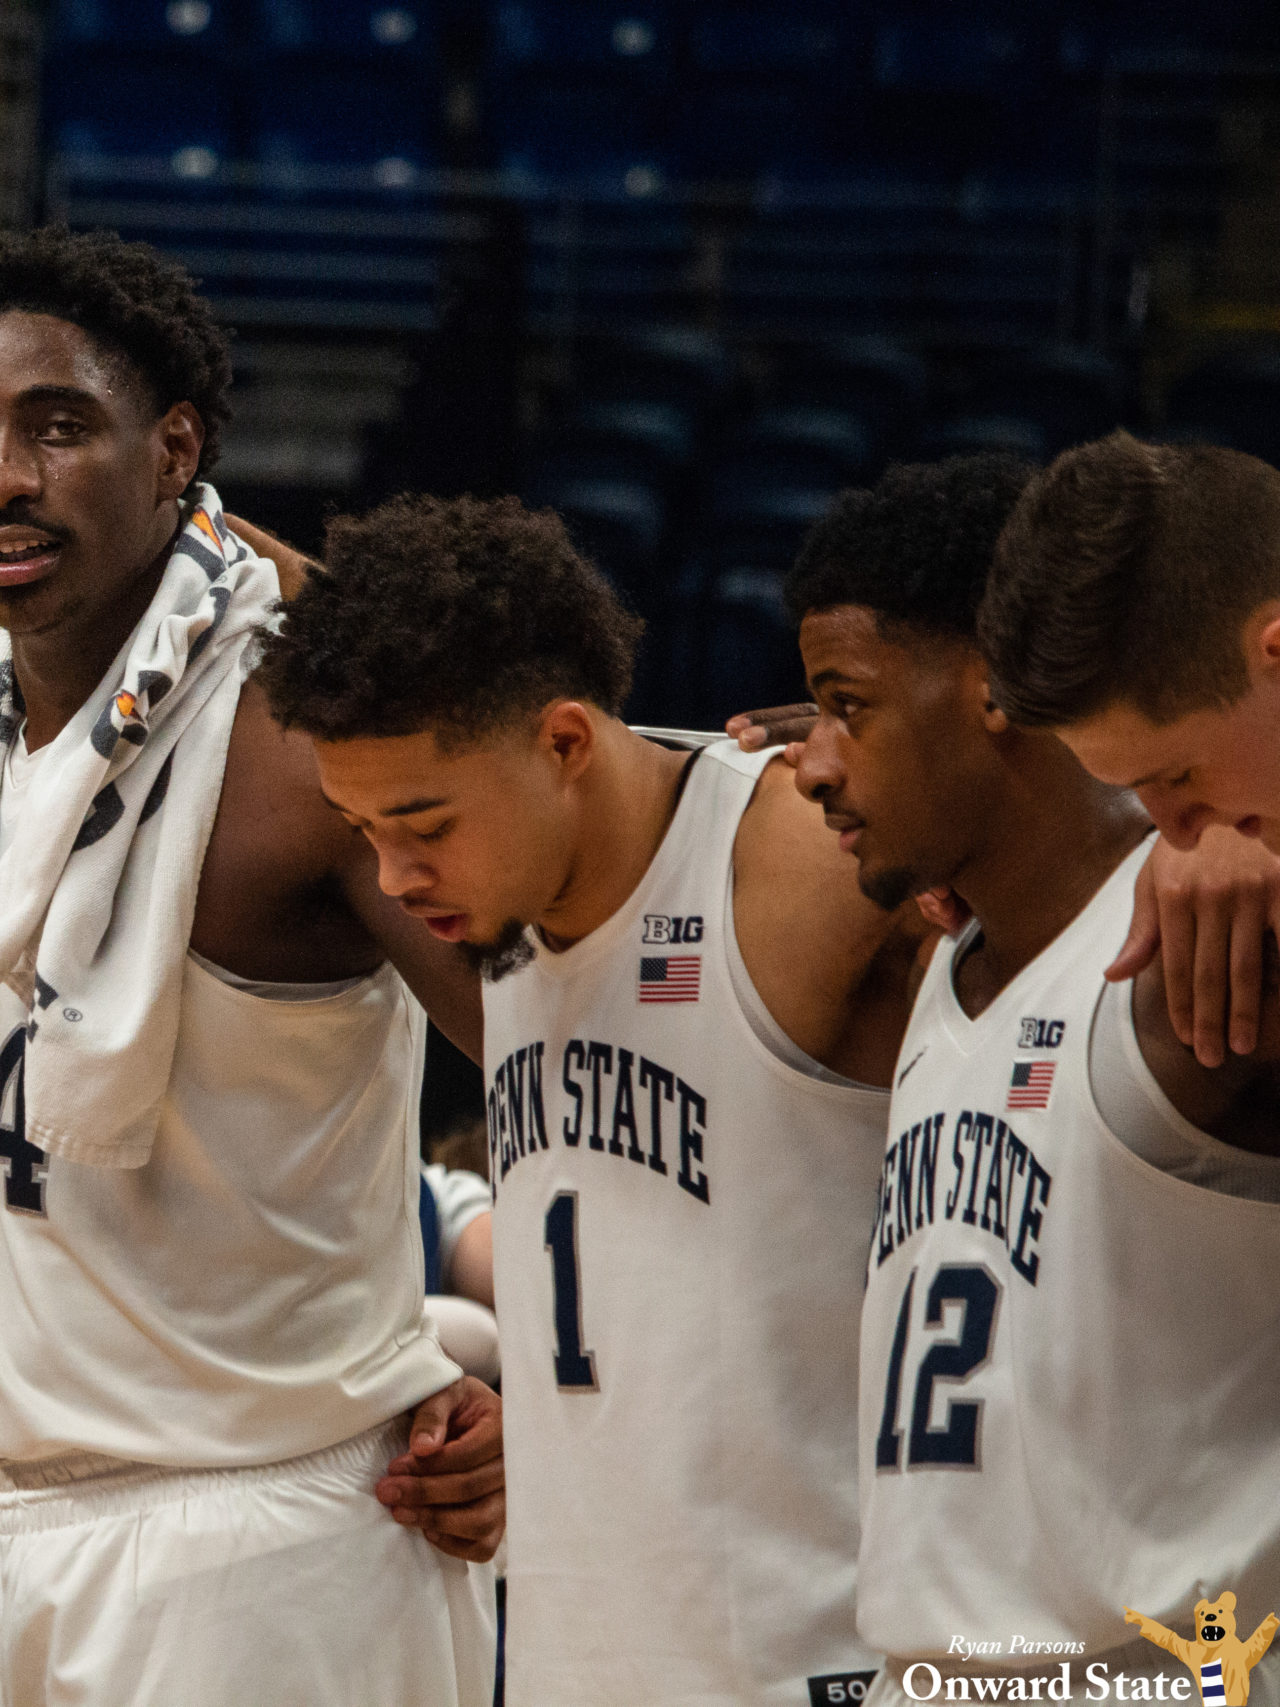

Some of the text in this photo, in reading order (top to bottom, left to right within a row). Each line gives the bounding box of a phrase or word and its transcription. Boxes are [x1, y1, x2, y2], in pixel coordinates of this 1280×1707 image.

[561, 1038, 711, 1206] STATE
[945, 1110, 1053, 1289] STATE
[544, 1189, 601, 1394] 1
[876, 1261, 1004, 1477] 12
[827, 1680, 868, 1703] 50
